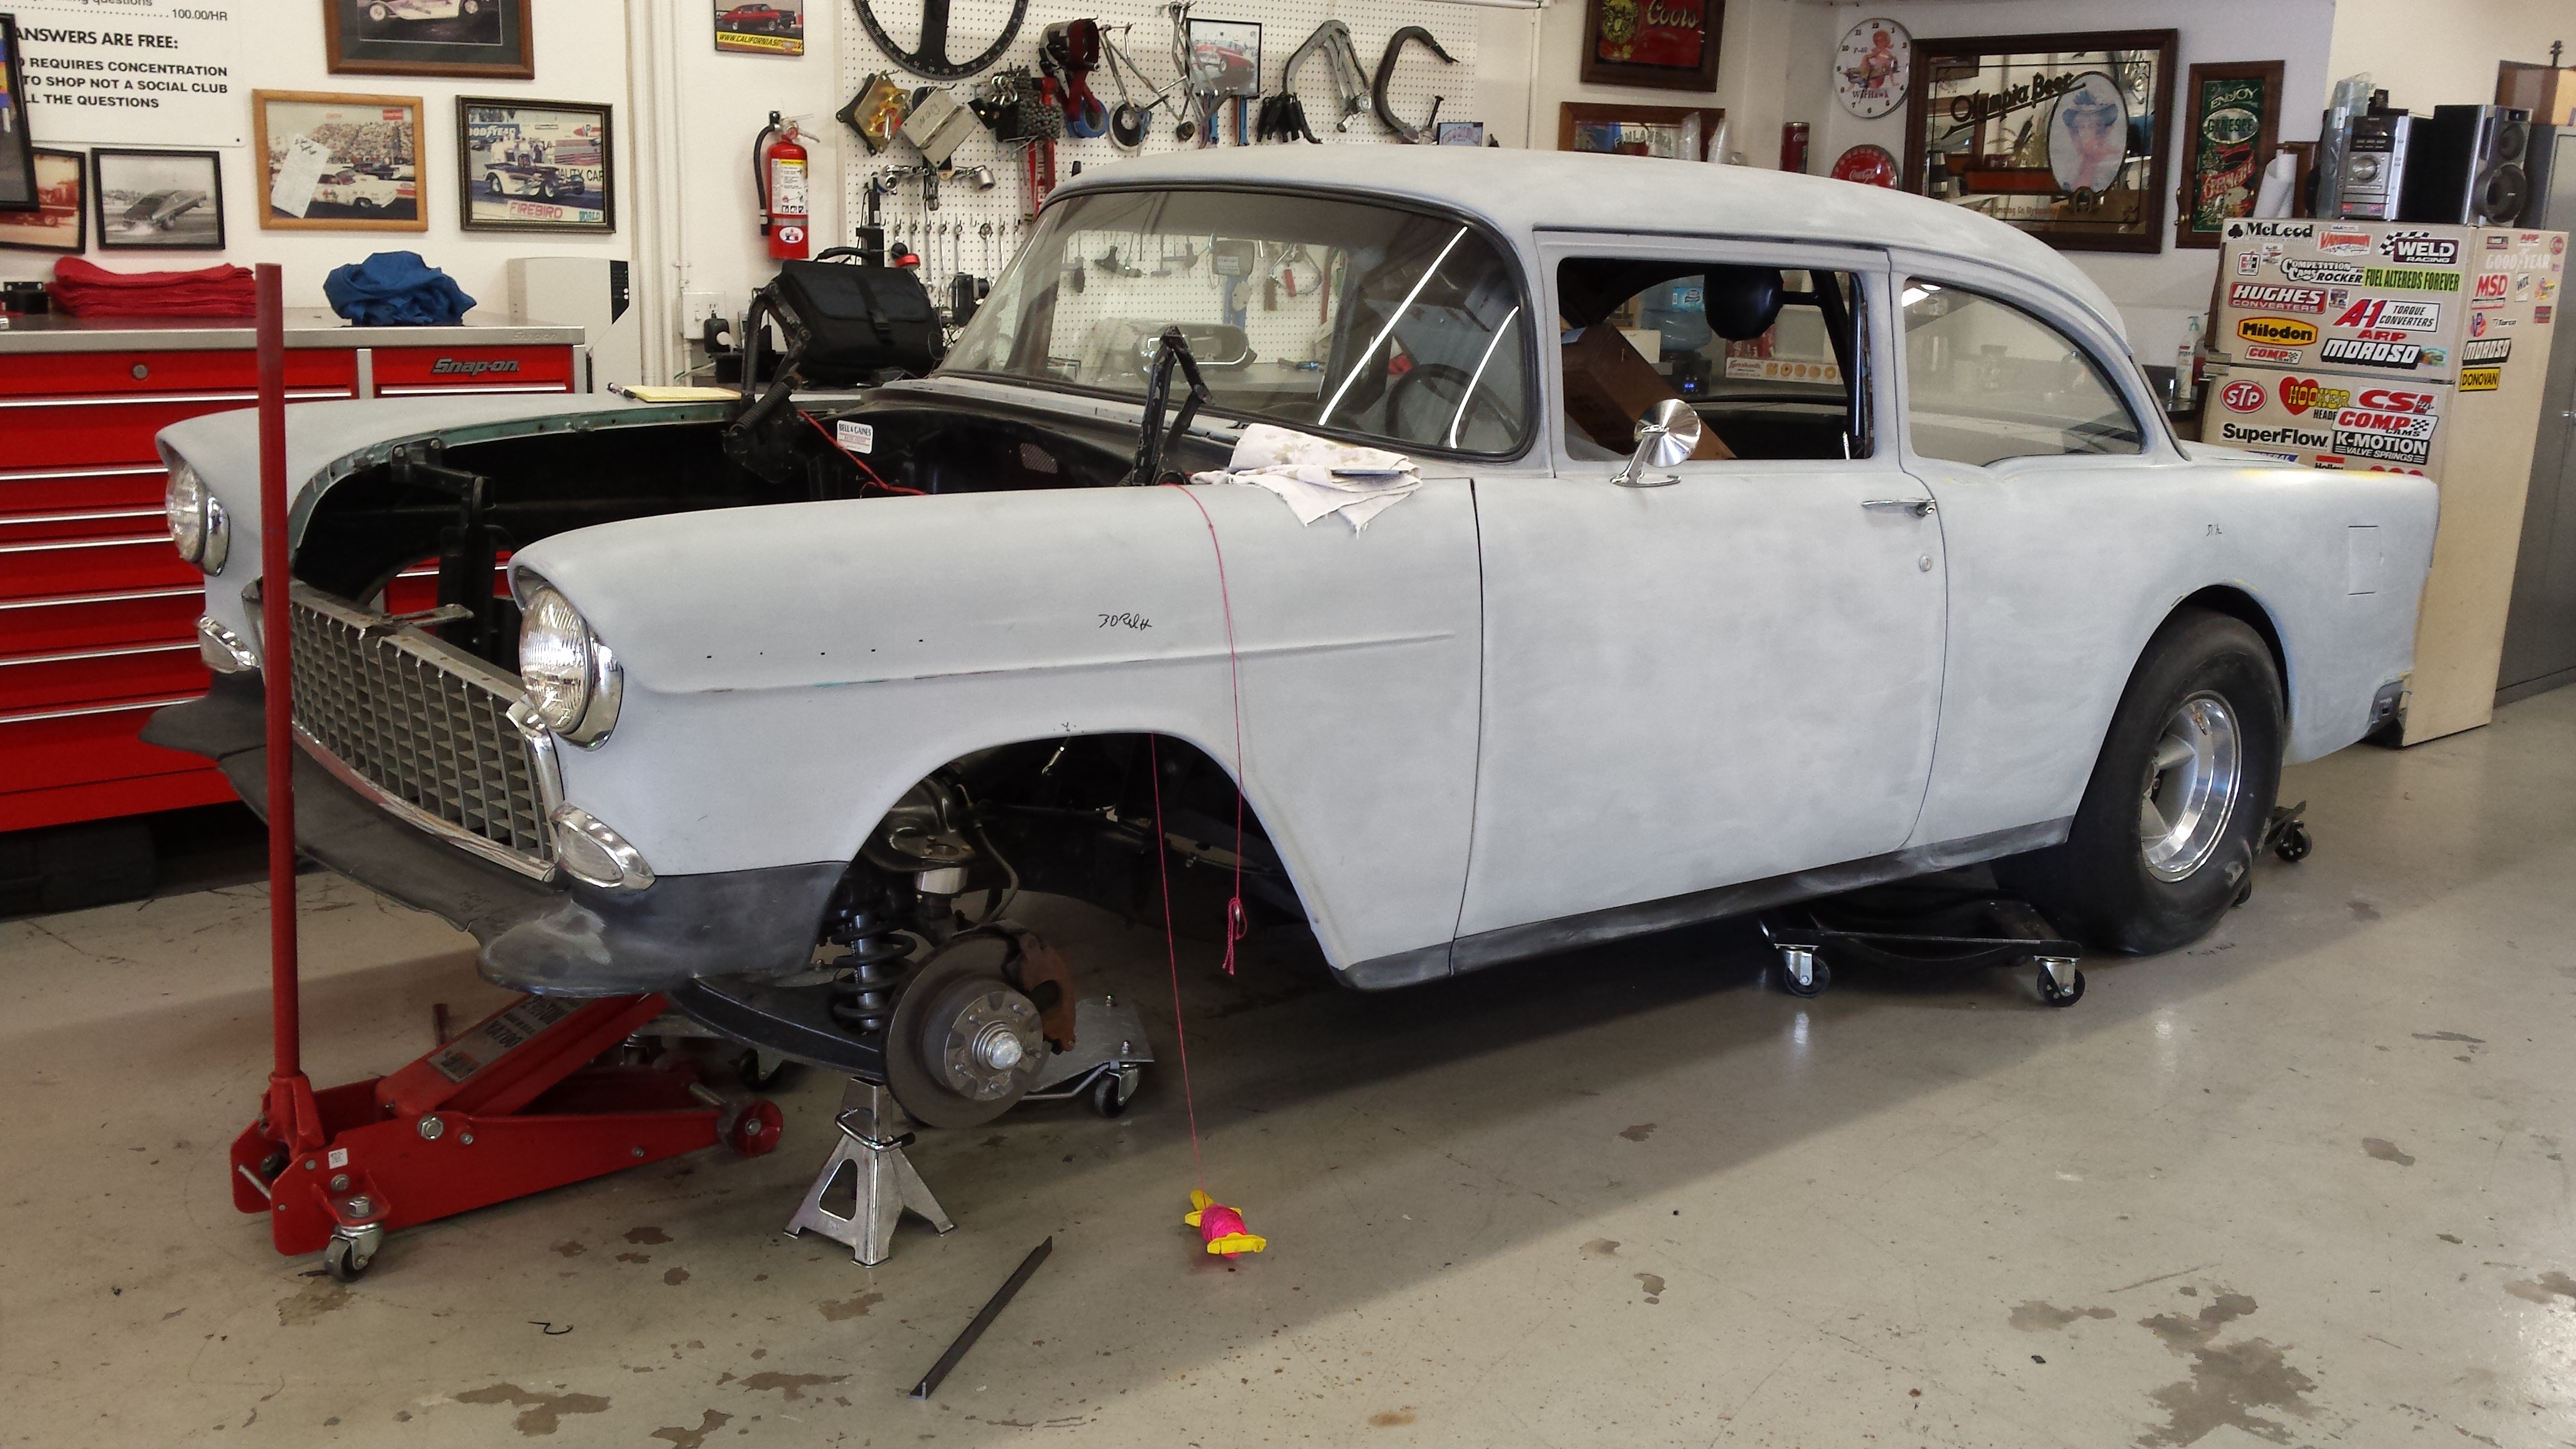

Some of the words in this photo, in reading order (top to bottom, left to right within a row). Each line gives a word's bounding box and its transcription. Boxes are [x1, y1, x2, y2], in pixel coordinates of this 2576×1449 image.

[172, 9, 228, 21] 100.00/HR
[16, 27, 97, 45] ANSWERS
[101, 32, 134, 47] ARE
[138, 35, 179, 49] FREE:
[30, 58, 104, 71] REQUIRES
[108, 61, 228, 77] CONCENTRATION
[46, 76, 85, 87] SHOP
[90, 79, 119, 89] NOT
[124, 80, 134, 89] A
[138, 80, 188, 92] SOCIAL
[192, 83, 228, 94] CLUB
[44, 94, 73, 105] THE
[77, 95, 160, 108] QUESTIONS
[1951, 83, 2029, 122] Olympia
[2032, 72, 2074, 103] Beer
[2210, 87, 2258, 110] ENJOY
[2207, 117, 2254, 133] GENESEE
[510, 202, 563, 219] FIREBIRD
[2246, 222, 2314, 238] McLeod
[2397, 241, 2456, 257] WELD
[2281, 258, 2352, 273] COMPETITION
[2288, 268, 2318, 281] CAMS
[2316, 273, 2363, 283] ROCKER
[2364, 268, 2383, 287] FUEL
[2383, 270, 2423, 290] ALTEREDS
[2423, 272, 2461, 292] FOREVER
[2233, 285, 2325, 305] HUGHES
[2476, 275, 2509, 298] MSD
[2232, 300, 2319, 313] CONVERTERS
[2393, 305, 2427, 316] TORQUE
[2379, 315, 2434, 328] CONVERTERS
[2242, 323, 2313, 341] Milodon
[2356, 329, 2407, 341] ARP
[2248, 348, 2289, 358] COMP
[2321, 338, 2421, 367] MOROSO
[2462, 339, 2512, 362] MOROSO
[2462, 373, 2498, 386] DONOVAN
[2226, 384, 2260, 407] STP
[2288, 386, 2350, 409] HOOKER
[2338, 411, 2411, 431] COMP
[2385, 428, 2421, 437] CAMS
[2336, 431, 2427, 455] K-MOTION
[2346, 446, 2373, 457] VALVE
[2373, 450, 2414, 463] SPRINGS
